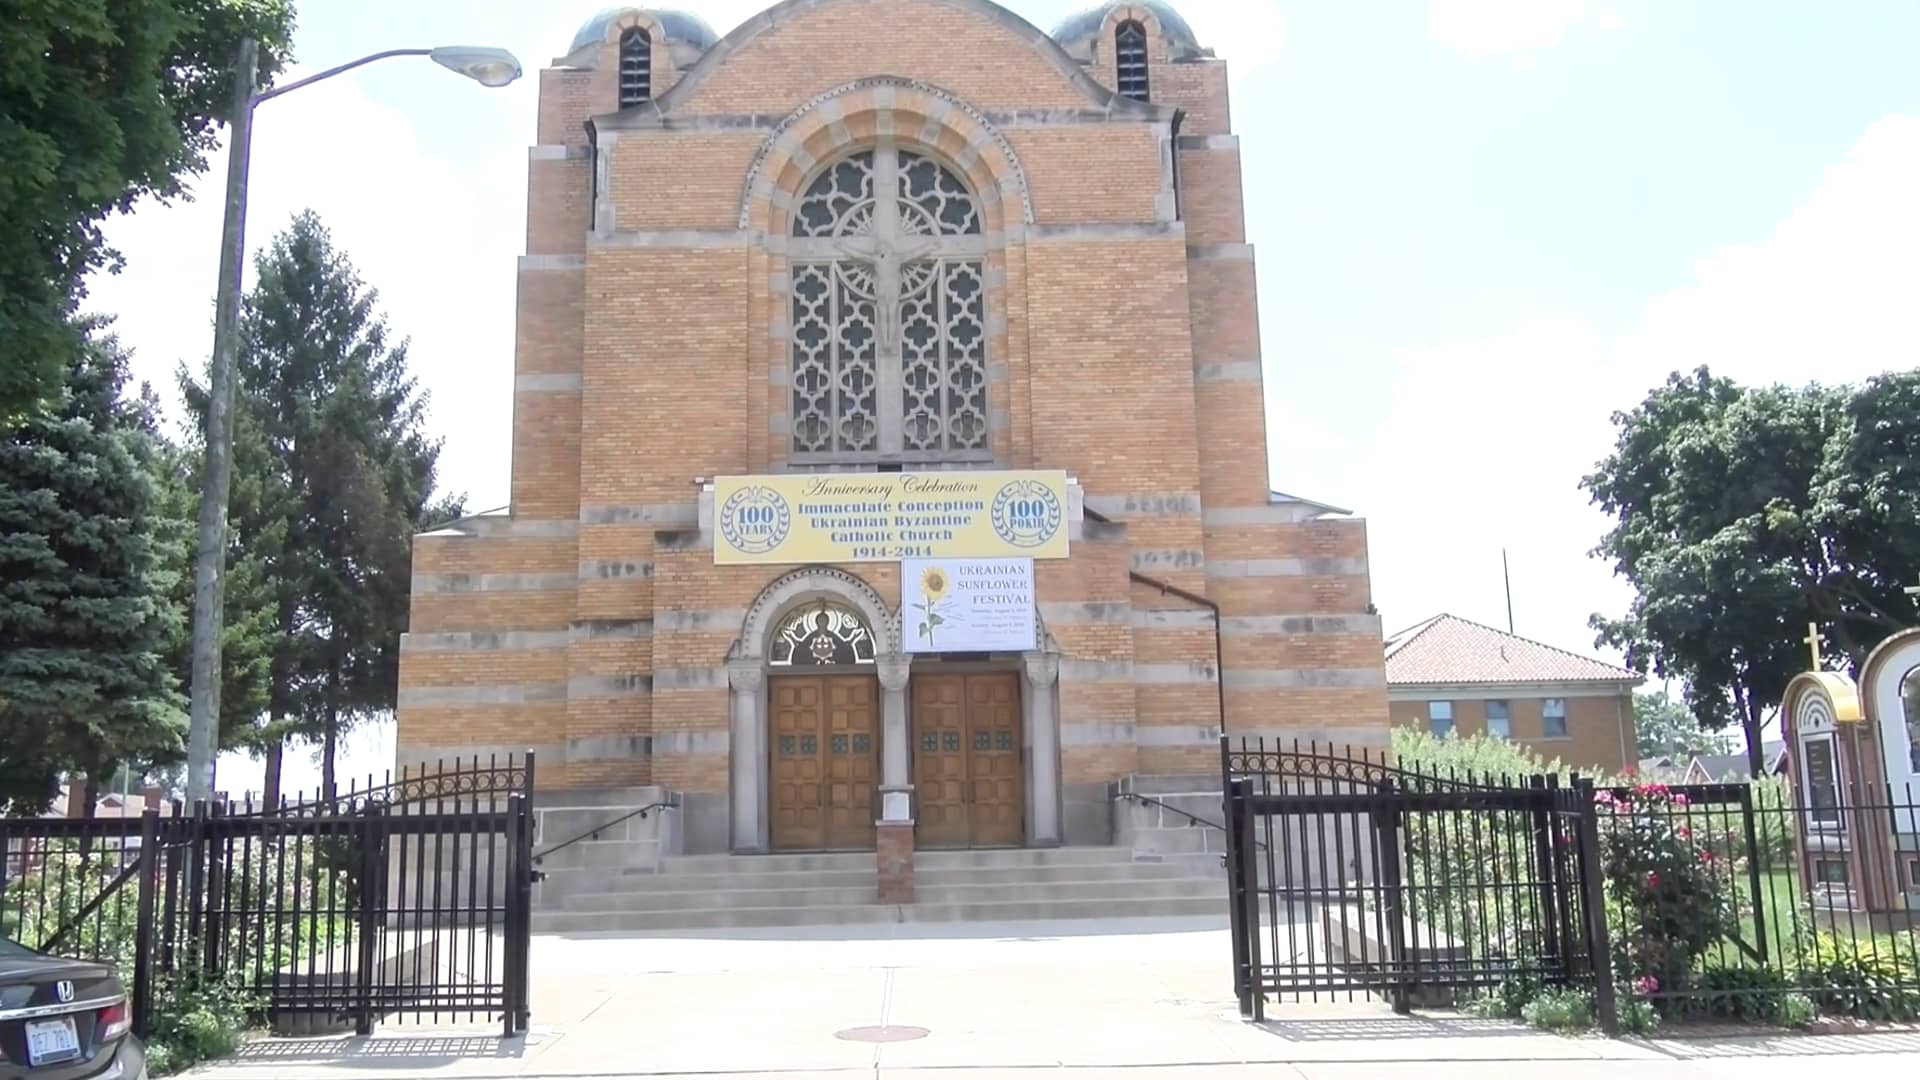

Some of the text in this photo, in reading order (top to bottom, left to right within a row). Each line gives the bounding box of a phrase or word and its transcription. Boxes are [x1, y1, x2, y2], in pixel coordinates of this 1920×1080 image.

[801, 474, 979, 499] Anniversary Celebration
[798, 499, 984, 514] Immaculate Conception
[1009, 499, 1045, 518] 100
[738, 506, 774, 524] 100
[811, 514, 972, 529] Ukrainian Byzantine
[738, 524, 773, 535] YEARS
[831, 529, 953, 543] Catholic Church
[852, 546, 932, 558] 1914-2014
[960, 564, 1025, 576] UKRAINIAN
[957, 579, 1028, 591] SUNFLOWER
[973, 594, 1030, 605] FESTIVAL
